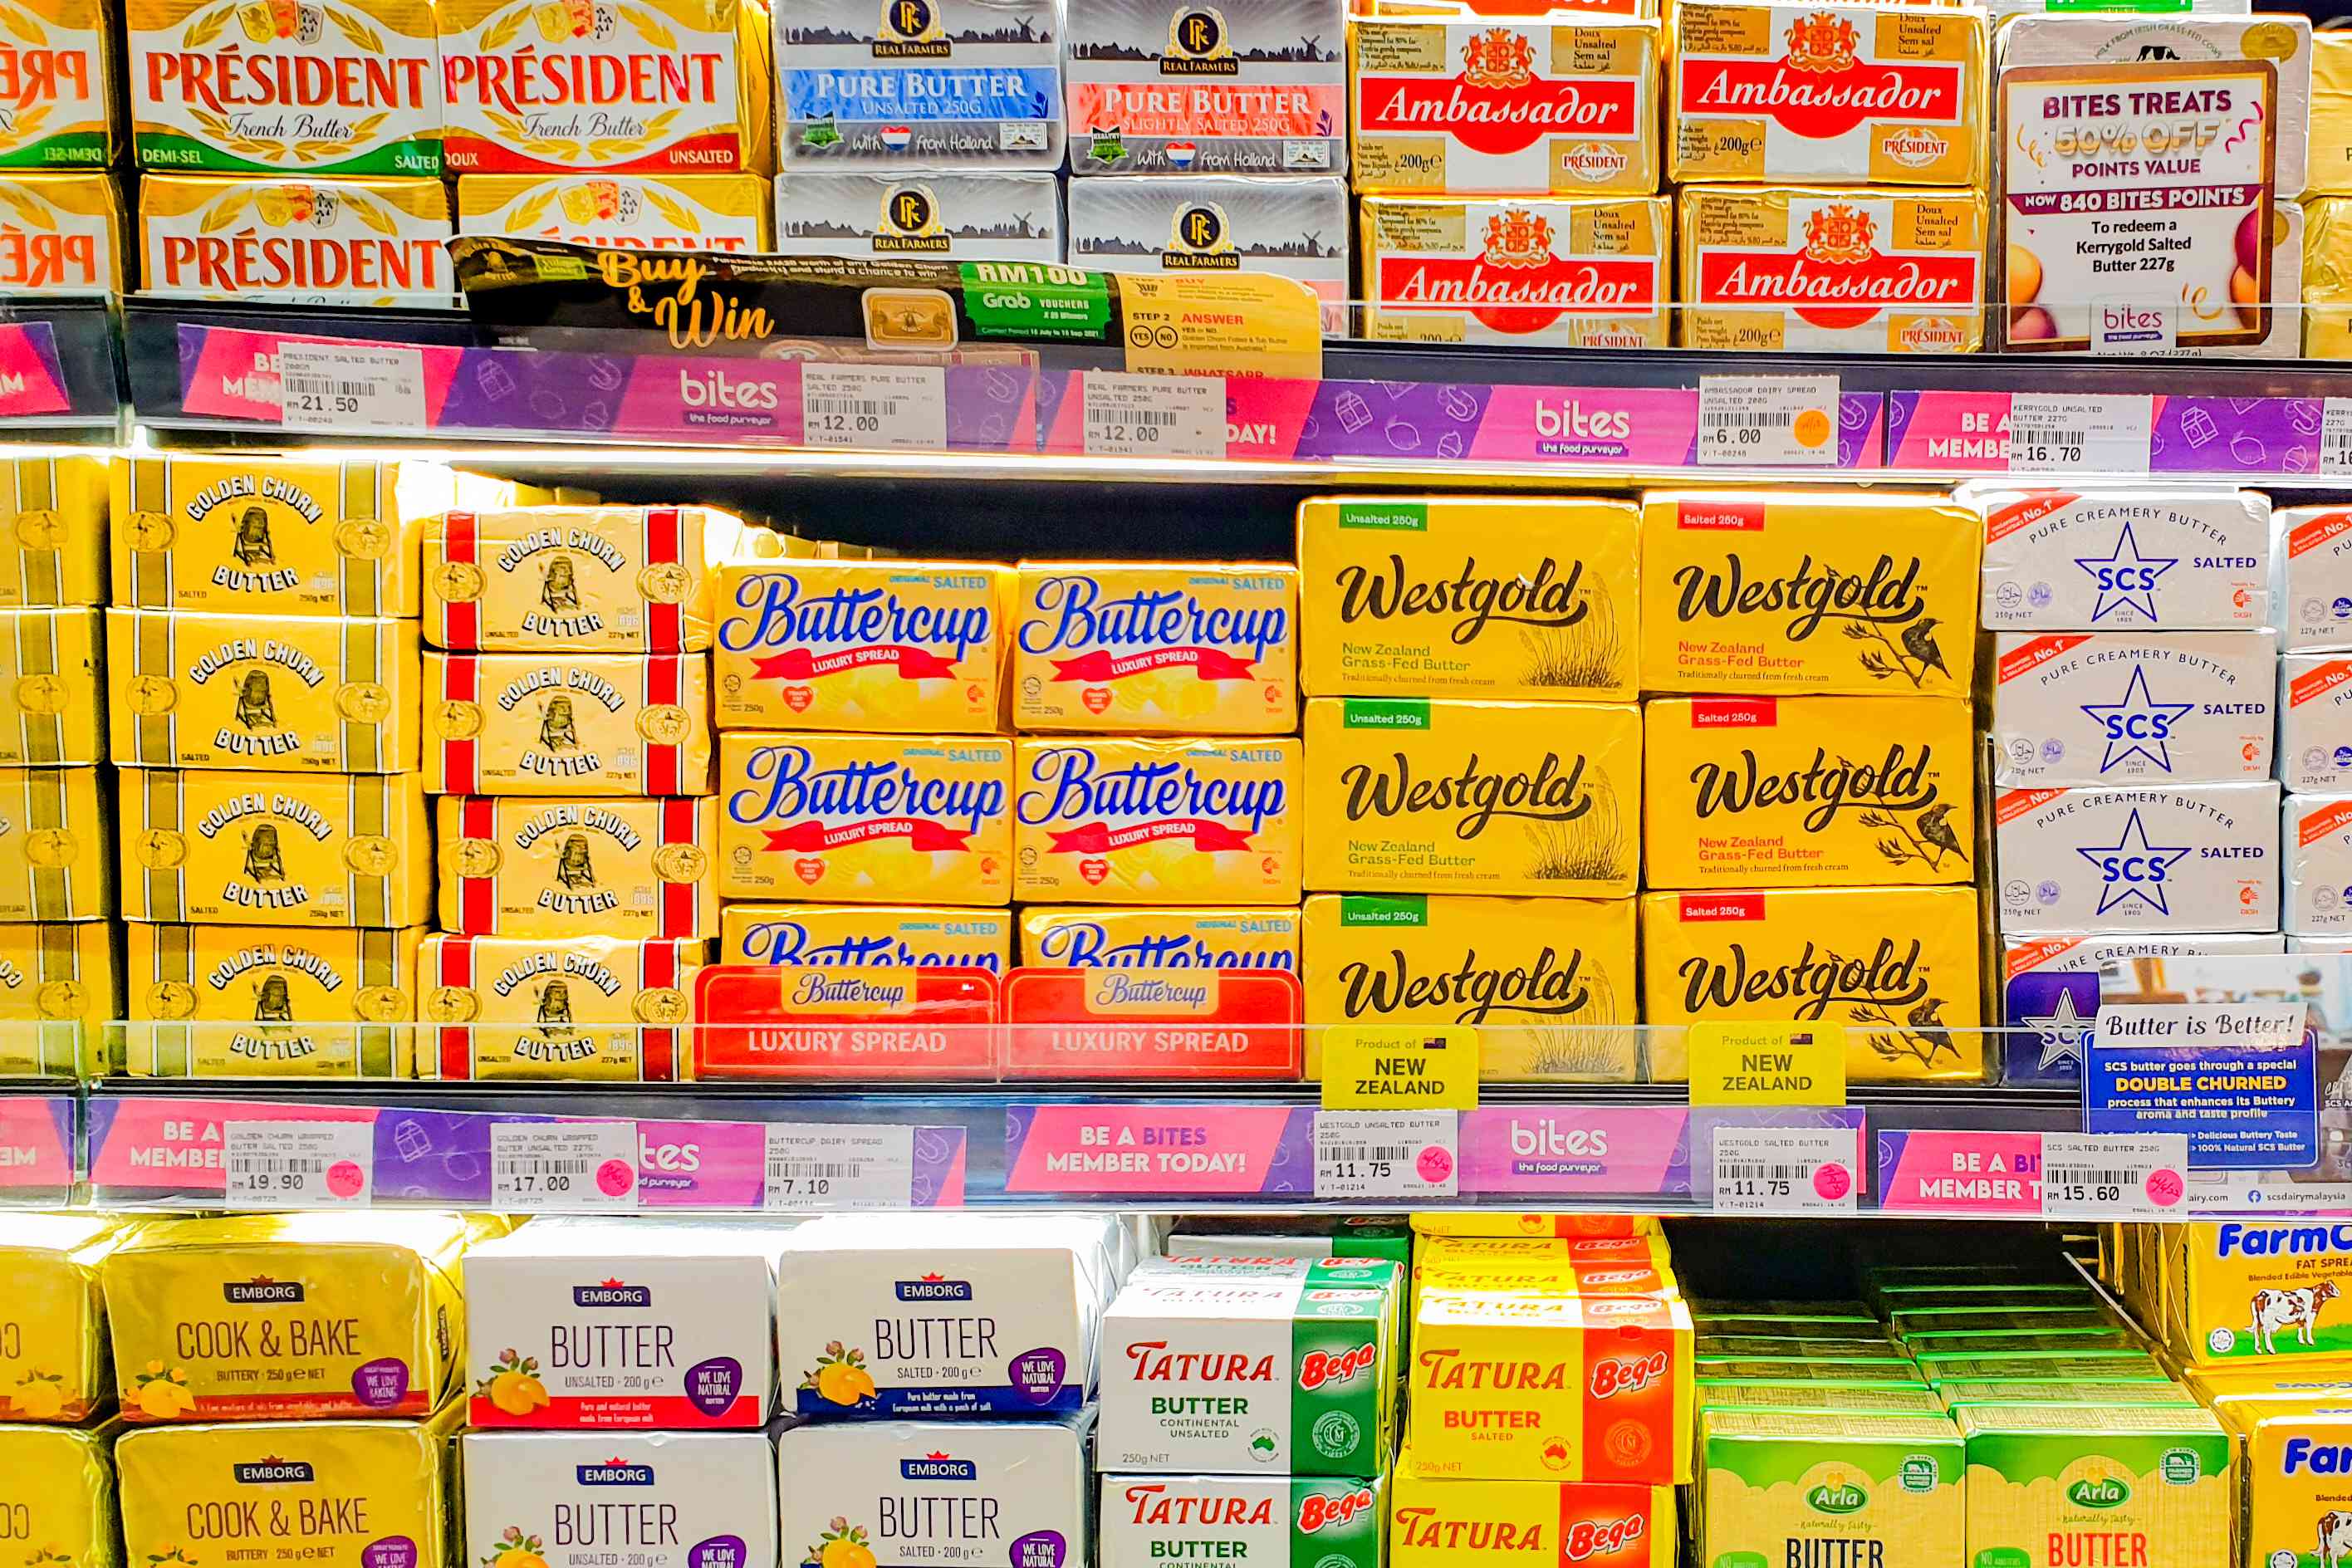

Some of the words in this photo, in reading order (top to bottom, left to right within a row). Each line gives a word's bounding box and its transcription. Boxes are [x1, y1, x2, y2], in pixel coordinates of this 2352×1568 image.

[875, 44, 899, 55] REAL
[902, 44, 948, 56] FARMERS
[1575, 39, 1616, 50] Unsalted
[1574, 51, 1593, 60] Sem
[1596, 51, 1610, 60] sal
[145, 43, 430, 115] PRÉSIDENT
[443, 44, 723, 115] PRÉSIDENT
[816, 74, 894, 98] PURE
[907, 73, 1028, 98] BUTTER
[1697, 71, 1941, 110] Ambassador
[863, 102, 938, 115] UNSALTED
[1105, 89, 1183, 114] PURE
[1193, 89, 1311, 114] BUTTER
[1375, 85, 1619, 125] Ambassador
[2042, 93, 2120, 119] BITES
[2129, 90, 2232, 114] TREATS
[226, 114, 286, 139] French
[294, 115, 353, 140] Butter
[1123, 119, 1190, 131] SLIGHTLY
[1198, 119, 1247, 132] SALTED
[916, 136, 947, 150] from
[949, 135, 993, 150] Holland
[2055, 122, 2137, 157] 50%
[2142, 119, 2220, 154] OFF
[143, 149, 203, 164] DEMI-SEL
[394, 154, 439, 169] SALTED
[669, 150, 733, 164] UNSALTED
[1563, 153, 1626, 170] PRÉSIDENT
[2071, 162, 2139, 179] POINTS
[2147, 159, 2201, 175] VALUE
[2025, 196, 2056, 207] NOW
[2060, 194, 2102, 213] 840
[2107, 191, 2161, 210] BITES
[2168, 187, 2246, 207] POINTS
[2091, 222, 2110, 235] To
[2113, 220, 2165, 234] redeem
[2168, 222, 2177, 231] a
[2076, 238, 2145, 256] Kerrygold
[2149, 238, 2192, 252] Salted
[163, 227, 440, 292] PRÉSIDENT
[2092, 260, 2136, 272] Butter
[2139, 257, 2175, 272] 227g
[597, 252, 706, 306] Buy
[976, 264, 1087, 285] RM100
[1716, 261, 1958, 299] Ambassador
[982, 293, 1031, 308] Grab
[627, 286, 654, 313] &
[654, 291, 776, 350] Win
[1133, 312, 1159, 321] STEP
[1182, 314, 1243, 326] ANSWER
[2104, 306, 2163, 330] bites
[680, 370, 777, 409] bites
[301, 396, 358, 412] 21.50
[824, 416, 879, 431] 12.00
[1536, 399, 1631, 439] bites
[1105, 426, 1159, 442] 12.00
[1717, 429, 1761, 444] 6.00
[2026, 447, 2080, 462] 16.70
[186, 473, 255, 522] GOLDEN
[261, 475, 323, 524] CHURN
[1345, 514, 1390, 525] Unsalted
[1684, 515, 1716, 525] Salted
[2029, 517, 2068, 544] PURE
[2075, 507, 2161, 524] CREAMERY
[2168, 512, 2227, 546] BUTTER
[2193, 556, 2256, 569] SALTED
[212, 565, 300, 592] BUTTER
[933, 576, 987, 589] SALTED
[2098, 568, 2154, 591] SCS
[1336, 554, 1589, 645] Westgold
[1673, 554, 1924, 642] Westgold
[718, 573, 991, 662] Buttercup
[1018, 576, 1287, 664] Buttercup
[1678, 641, 1708, 654] New
[1712, 642, 1765, 654] Zealand
[812, 654, 854, 674] LUXURY
[856, 649, 899, 663] SPREAD
[1678, 654, 1753, 667] Grass-Fed
[1758, 656, 1805, 669] Butter
[2106, 714, 2168, 739] SCS
[1690, 744, 1938, 833] Westgold
[515, 806, 579, 849] GOLDEN
[585, 806, 641, 851] CHURN
[1700, 865, 1747, 874] Traditionally
[1750, 864, 1781, 874] churned
[1783, 863, 1802, 872] from
[1804, 862, 1824, 871] fresh
[2102, 857, 2165, 882] SCS
[538, 889, 619, 914] BUTTER
[792, 973, 904, 1007] Buttercup
[1339, 946, 1589, 1025] Westgold
[2105, 1016, 2178, 1036] Butter
[2187, 1016, 2207, 1035] is
[2216, 1014, 2295, 1036] Better!
[748, 1031, 845, 1052] LUXURY
[850, 1031, 946, 1053] SPREAD
[1355, 1039, 1400, 1050] Product
[1405, 1039, 1416, 1049] of
[1375, 1058, 1426, 1076] NEW
[2105, 1061, 2128, 1072] SCS
[2130, 1061, 2166, 1072] butter
[2169, 1063, 2196, 1072] goes
[2199, 1061, 2243, 1071] through
[2256, 1060, 2296, 1071] special
[1355, 1080, 1444, 1095] ZEALAND
[2115, 1077, 2193, 1092] DOUBLE
[2197, 1076, 2286, 1091] CHURNED
[2108, 1098, 2152, 1109] process
[2154, 1096, 2178, 1106] that
[2180, 1096, 2233, 1106] enhances
[2237, 1096, 2249, 1106] its
[2253, 1096, 2296, 1107] Buttery
[2136, 1110, 2173, 1120] aroma
[2175, 1109, 2196, 1119] and
[2199, 1109, 2228, 1119] taste
[2231, 1109, 2267, 1120] profile
[1080, 1126, 1110, 1146] BE
[1116, 1126, 1136, 1146] A
[1144, 1127, 1206, 1146] BITES
[1046, 1152, 1149, 1173] MEMBER
[1157, 1153, 1246, 1174] TODAY!
[1335, 1164, 1391, 1178] 11.75
[248, 1175, 303, 1190] 19.90
[514, 1177, 570, 1192] 17.00
[783, 1180, 829, 1195] 7.10
[1735, 1181, 1790, 1196] 11.75
[2064, 1186, 2119, 1201] 15.60
[2266, 1192, 2345, 1202] scsdairymalaysia
[2296, 1260, 2317, 1269] FAT
[233, 1286, 296, 1299] EMBORG
[582, 1291, 642, 1302] EMBORG
[176, 1321, 251, 1360] COOK
[260, 1325, 282, 1357] &
[290, 1319, 361, 1357] BAKE
[551, 1325, 674, 1368] BUTTER
[1126, 1341, 1280, 1381] TATURA
[1300, 1343, 1376, 1390] Bega
[1419, 1349, 1570, 1389] TATURA
[217, 1370, 258, 1382] BUTTERY
[566, 1375, 614, 1388] UNSALTED
[1591, 1351, 1668, 1399] Bega
[1152, 1398, 1248, 1414] BUTTER
[1160, 1419, 1239, 1428] CONTINENTAL
[1444, 1411, 1540, 1428] BUTTER
[1170, 1430, 1229, 1438] UNSALTED
[1472, 1433, 1513, 1441] SALTED
[1122, 1453, 1148, 1465] 250g
[1150, 1454, 1169, 1463] NET
[1815, 1489, 1859, 1506] Arla
[2075, 1483, 2119, 1500] Arla
[2062, 1514, 2108, 1526] Naturally
[2048, 1533, 2148, 1567] BUTTER
